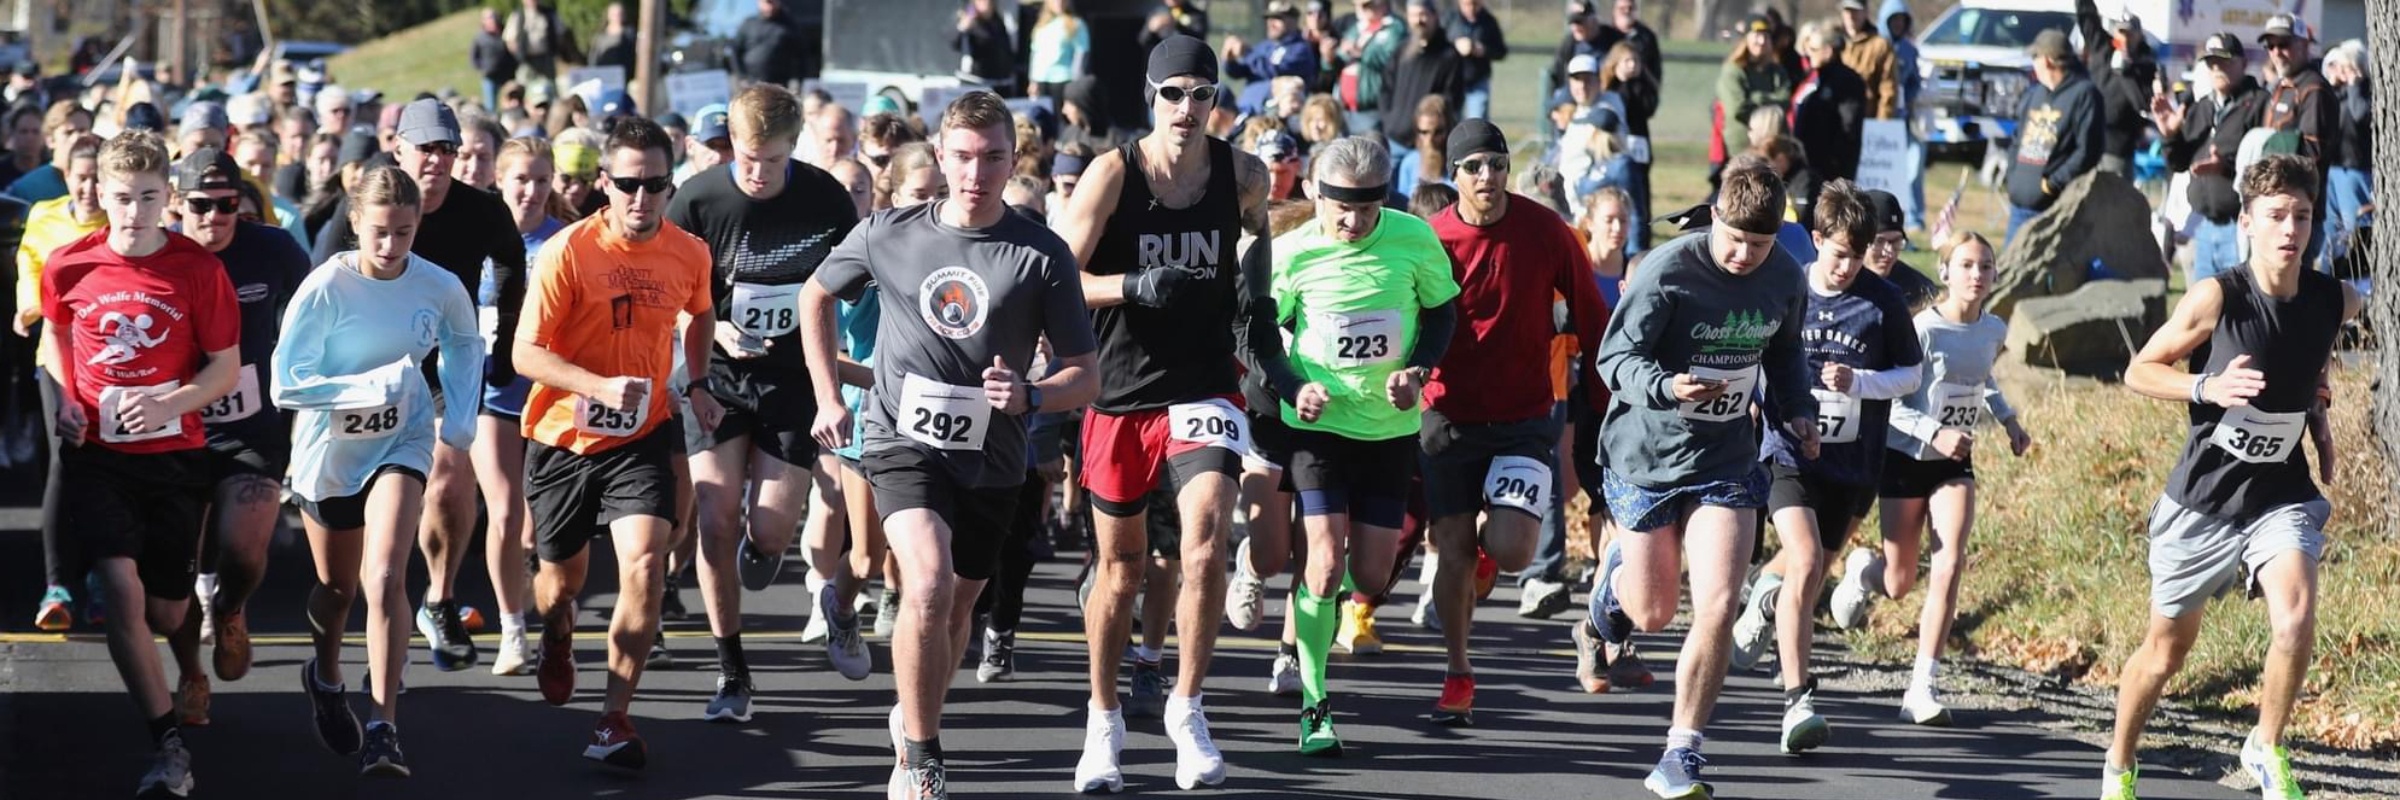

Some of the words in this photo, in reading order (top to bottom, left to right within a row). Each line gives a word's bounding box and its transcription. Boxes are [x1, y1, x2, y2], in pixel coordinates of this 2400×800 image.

[1138, 229, 1220, 268] RUN
[133, 290, 185, 321] Memorial
[744, 307, 793, 330] 218
[1690, 321, 1731, 340] Cross
[1337, 333, 1388, 359] 223
[588, 403, 639, 430] 253
[1693, 391, 1744, 416] 262
[1940, 405, 1978, 426] 233
[344, 406, 398, 434] 248
[913, 407, 972, 443] 292
[1186, 415, 1239, 442] 209
[1817, 415, 1846, 437] 57
[2228, 427, 2285, 457] 365
[1493, 476, 1540, 506] 204
